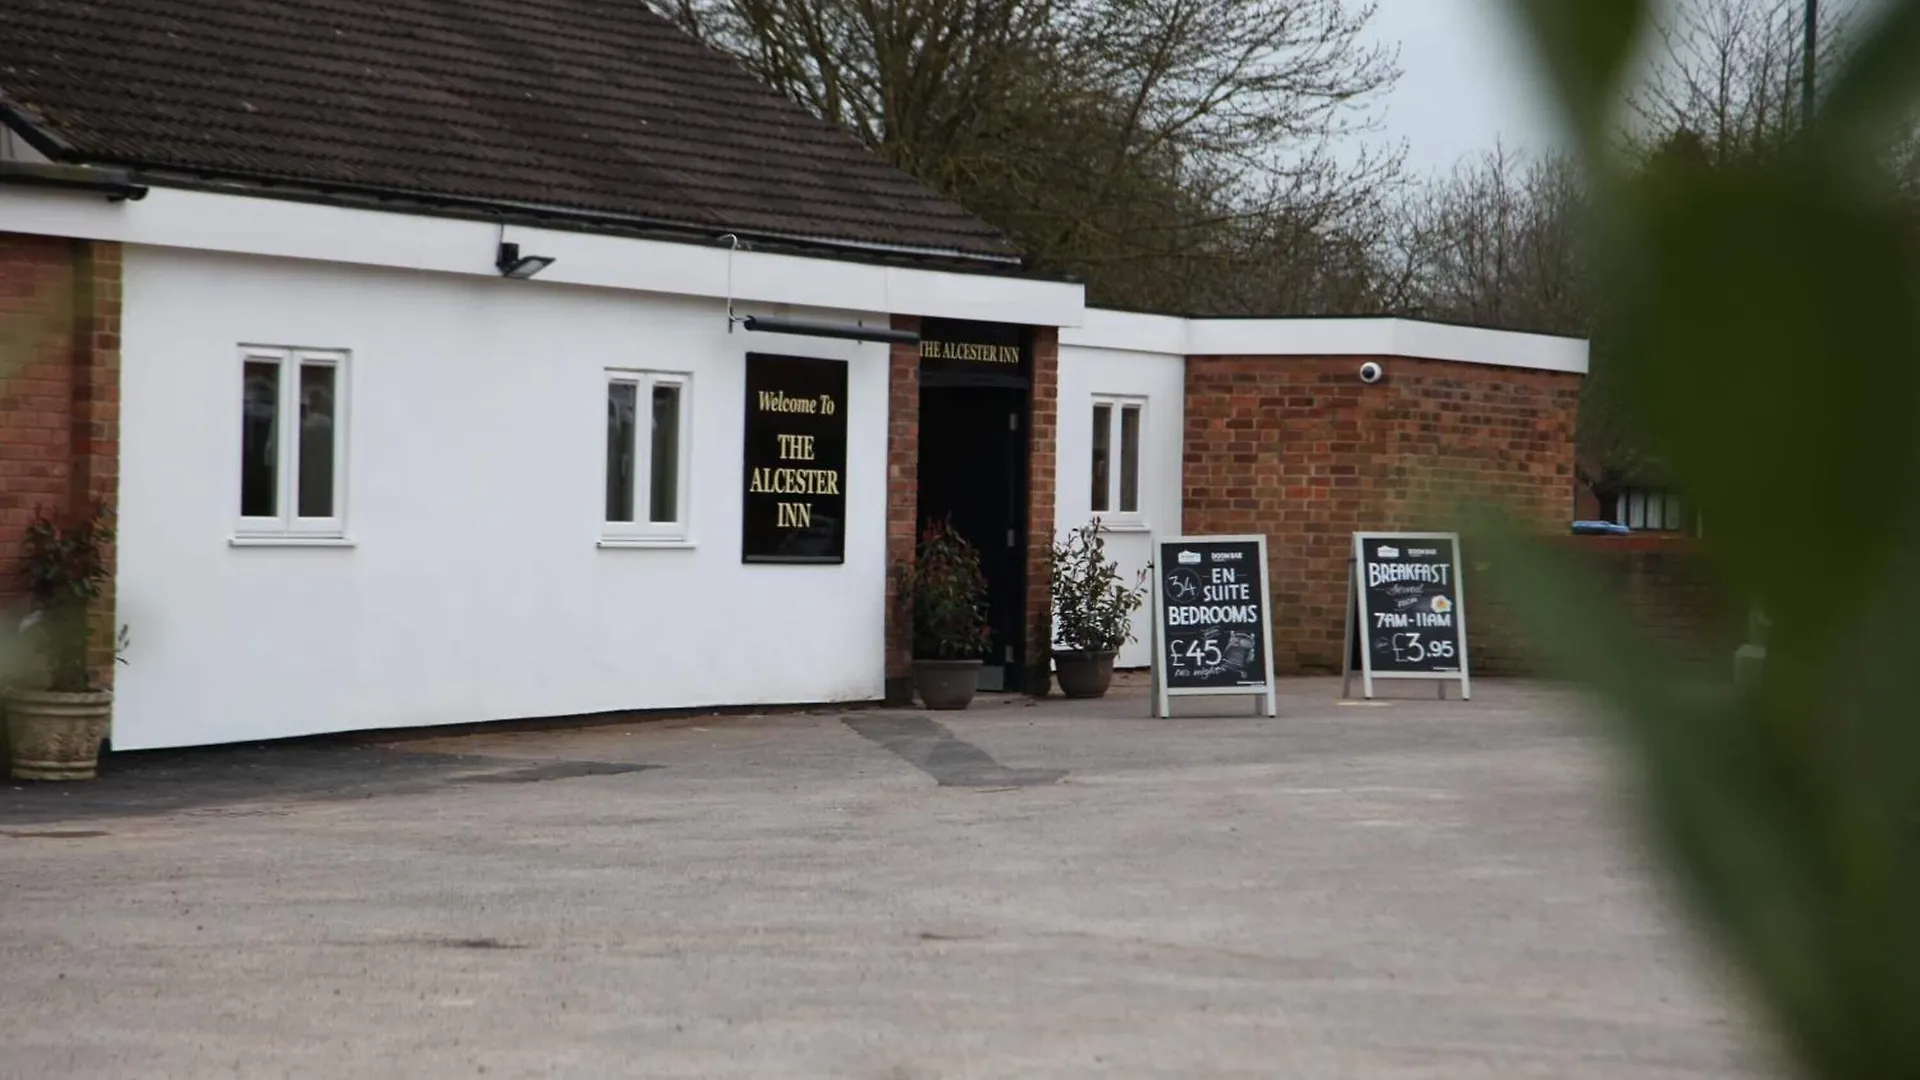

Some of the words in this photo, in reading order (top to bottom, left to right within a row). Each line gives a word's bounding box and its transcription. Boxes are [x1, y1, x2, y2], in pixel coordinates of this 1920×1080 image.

[920, 340, 940, 358] THE
[942, 342, 997, 361] ALCESTER
[999, 346, 1019, 363] INN
[758, 390, 816, 414] Welcome
[820, 394, 835, 415] To
[777, 434, 815, 460] THE
[750, 467, 839, 495] ALCESTER
[777, 502, 811, 527] INN
[1169, 576, 1196, 597] 34
[1212, 568, 1235, 583] EN
[1368, 562, 1450, 587] BREAKFAST
[1203, 584, 1250, 602] SUITE
[1168, 605, 1258, 625] BEDROOMS
[1170, 639, 1222, 666] £45
